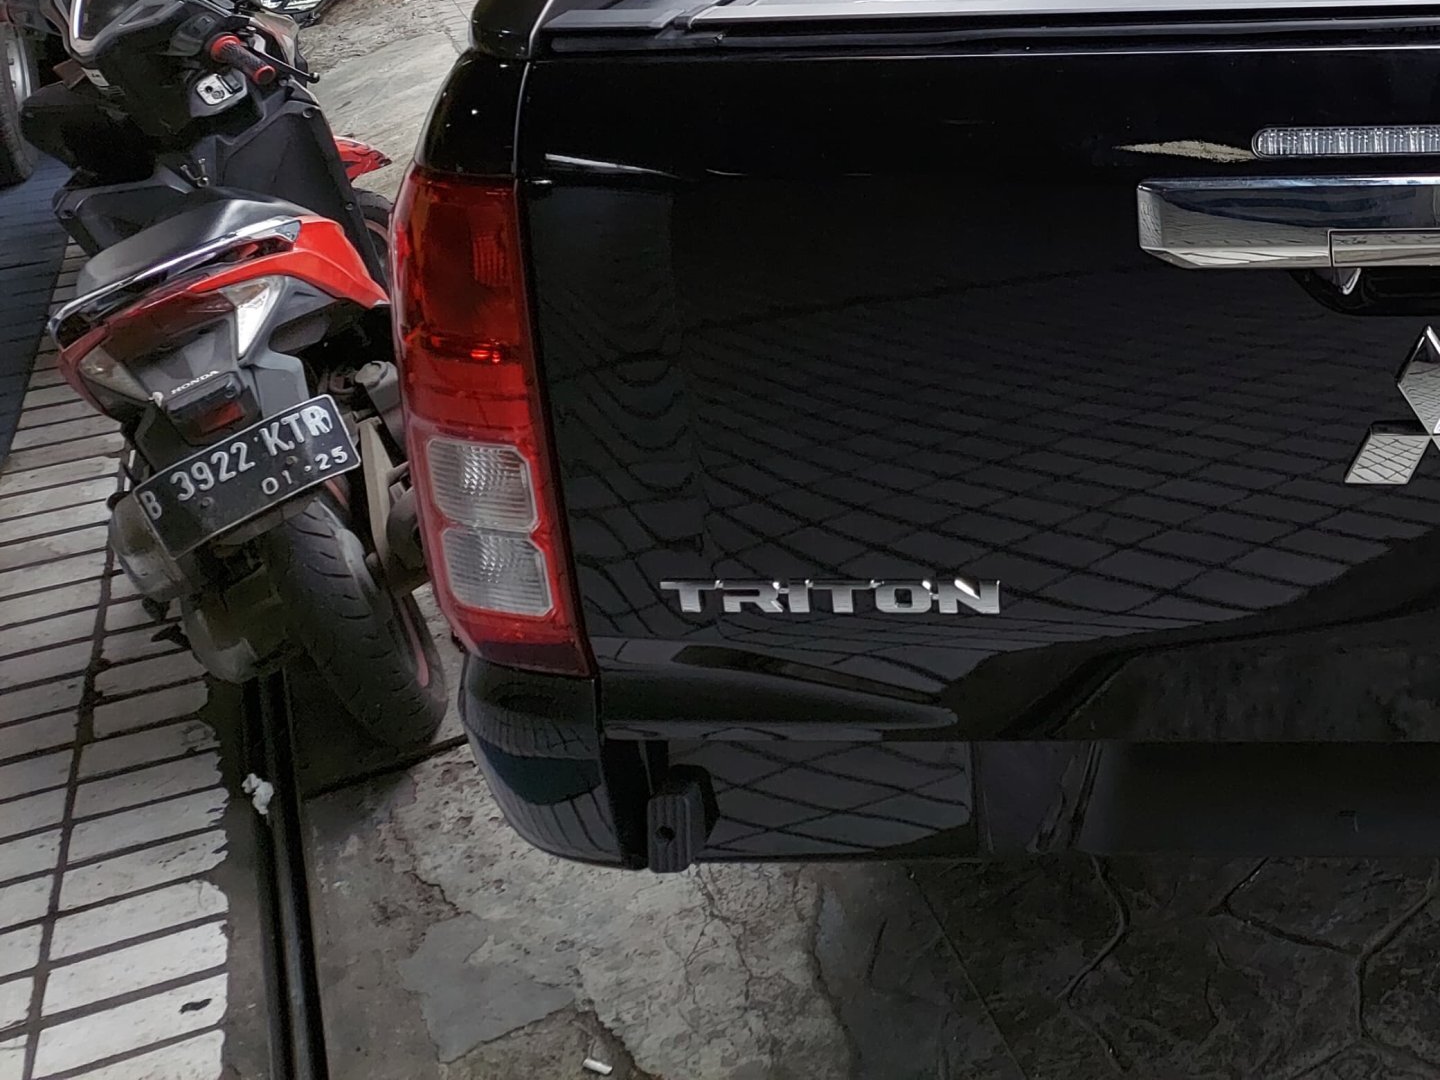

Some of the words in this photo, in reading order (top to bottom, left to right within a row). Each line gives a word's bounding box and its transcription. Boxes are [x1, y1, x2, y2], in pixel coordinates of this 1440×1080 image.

[171, 370, 220, 395] HONDA
[140, 490, 163, 520] B
[170, 441, 256, 502] 3922
[660, 579, 1000, 614] TRITON
